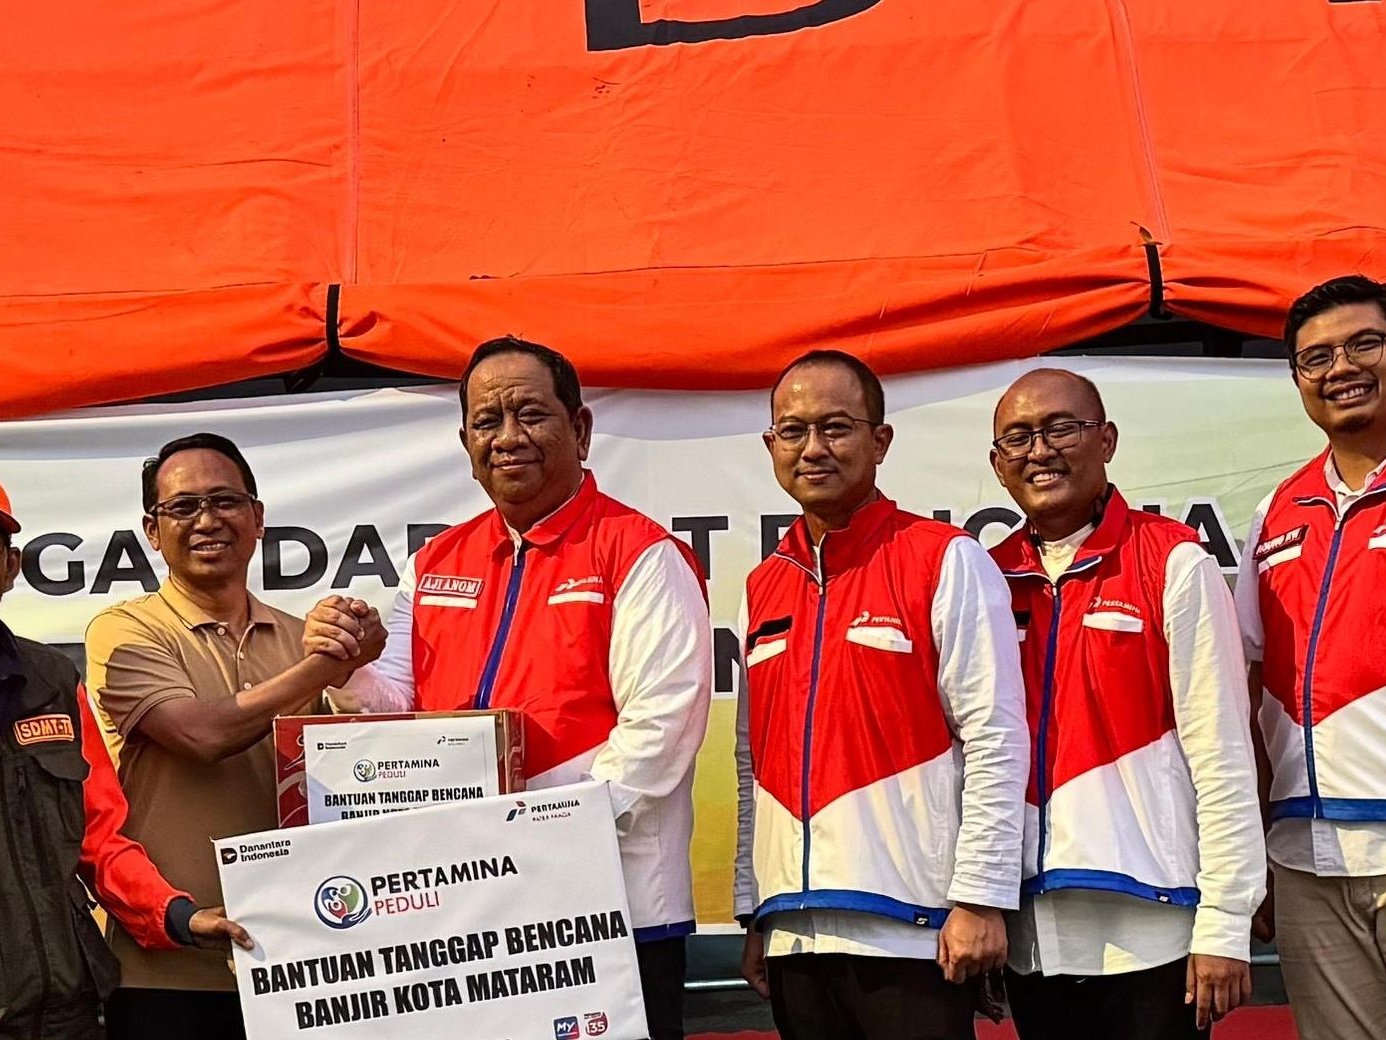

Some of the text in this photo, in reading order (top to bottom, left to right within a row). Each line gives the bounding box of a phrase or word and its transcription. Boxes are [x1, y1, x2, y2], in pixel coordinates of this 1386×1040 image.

[377, 759, 440, 770] PERTAMINA
[324, 787, 484, 807] BANTUAN TANGGAP BENCANA
[239, 840, 291, 853] Danantara
[370, 855, 518, 897] PERTAMINA
[374, 890, 441, 916] PEDULI
[251, 910, 629, 995] BANTUAN TANGGAP BENCANA
[295, 956, 596, 1031] BANJIR KOTA MATARAM
